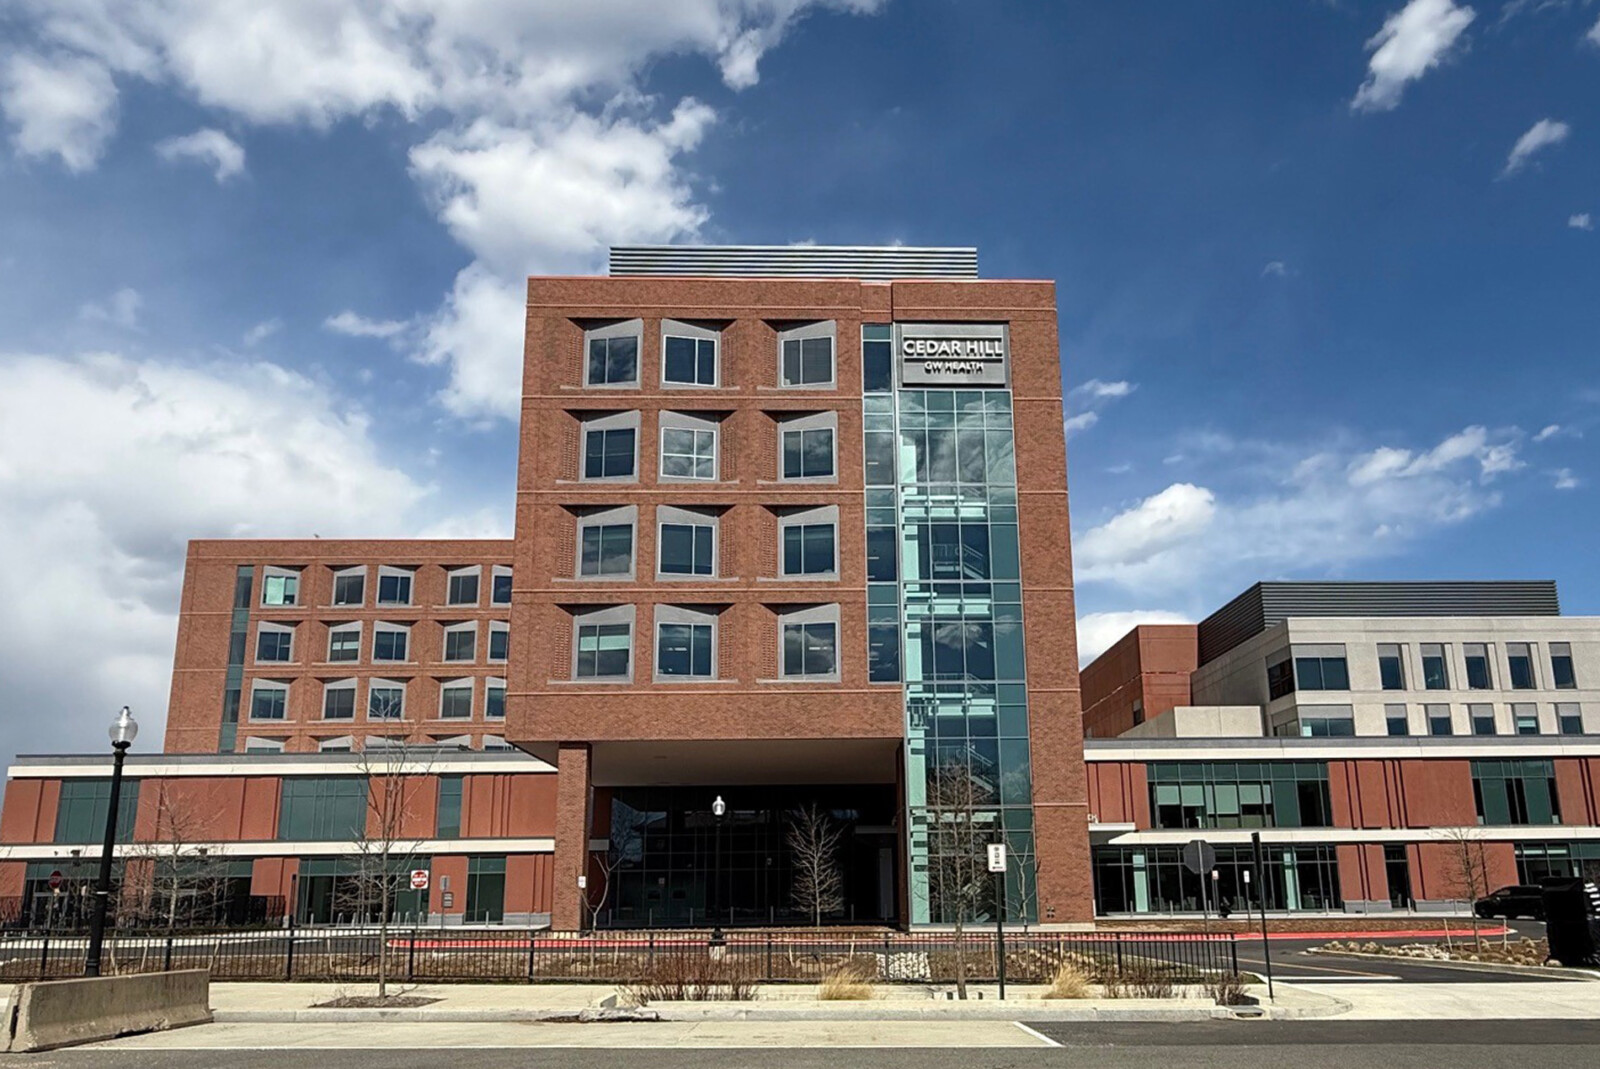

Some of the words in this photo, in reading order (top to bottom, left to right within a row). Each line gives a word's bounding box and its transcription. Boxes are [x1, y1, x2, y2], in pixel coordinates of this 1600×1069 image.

[903, 340, 961, 354] CEDAR
[966, 340, 1003, 354] HILL
[924, 361, 942, 371] GW
[945, 361, 984, 371] HEALTH
